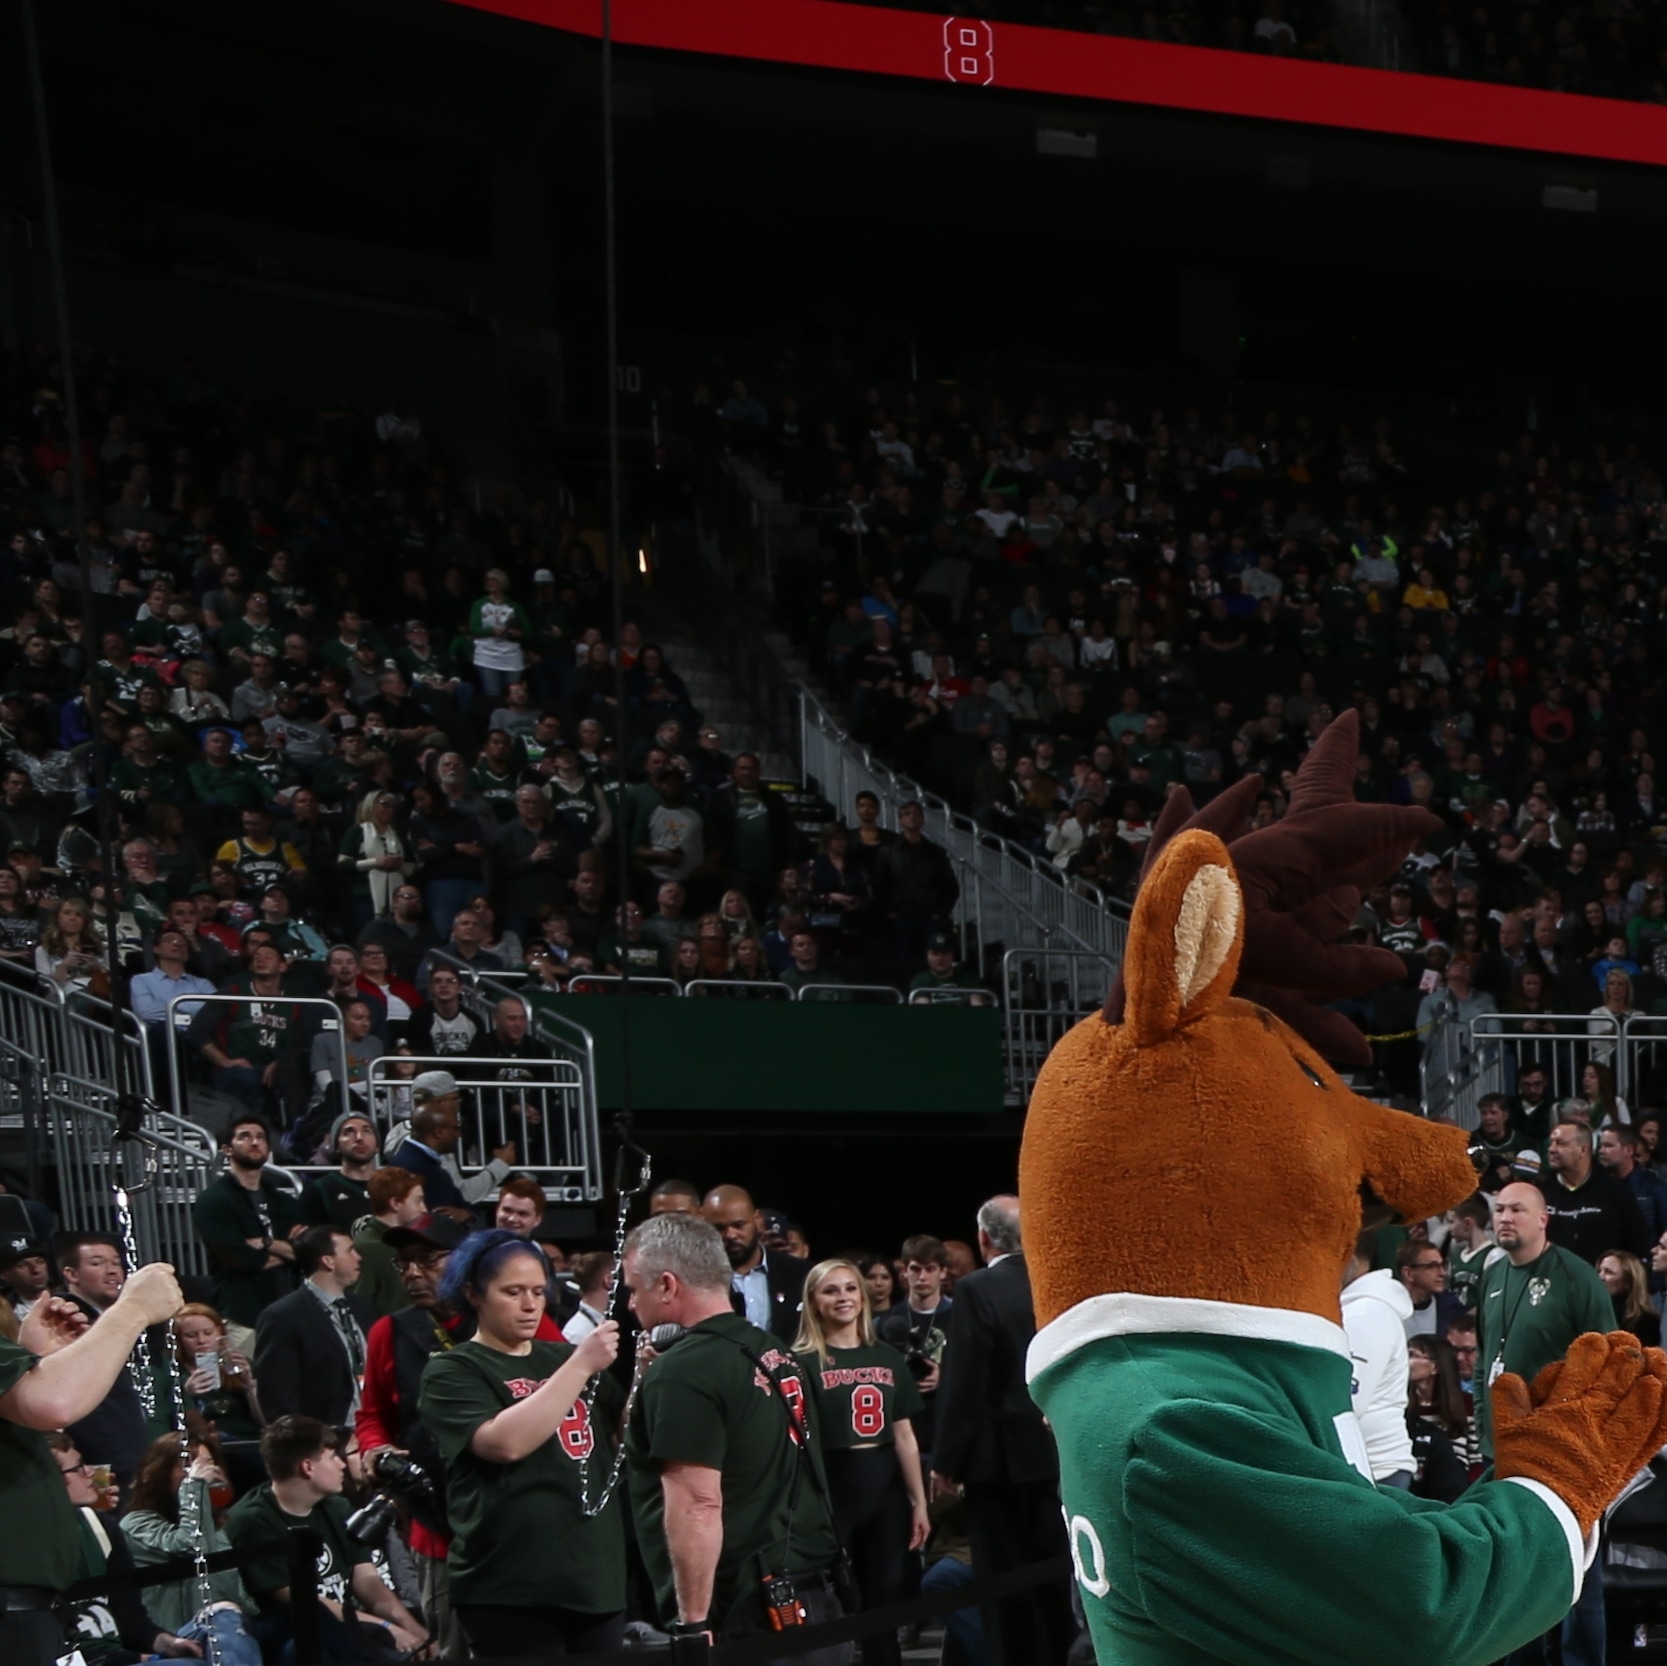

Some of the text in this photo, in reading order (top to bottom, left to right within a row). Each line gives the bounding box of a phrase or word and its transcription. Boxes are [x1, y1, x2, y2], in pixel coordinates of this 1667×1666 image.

[943, 16, 994, 87] 8
[820, 1366, 895, 1390] BUCK
[851, 1384, 885, 1437] 8
